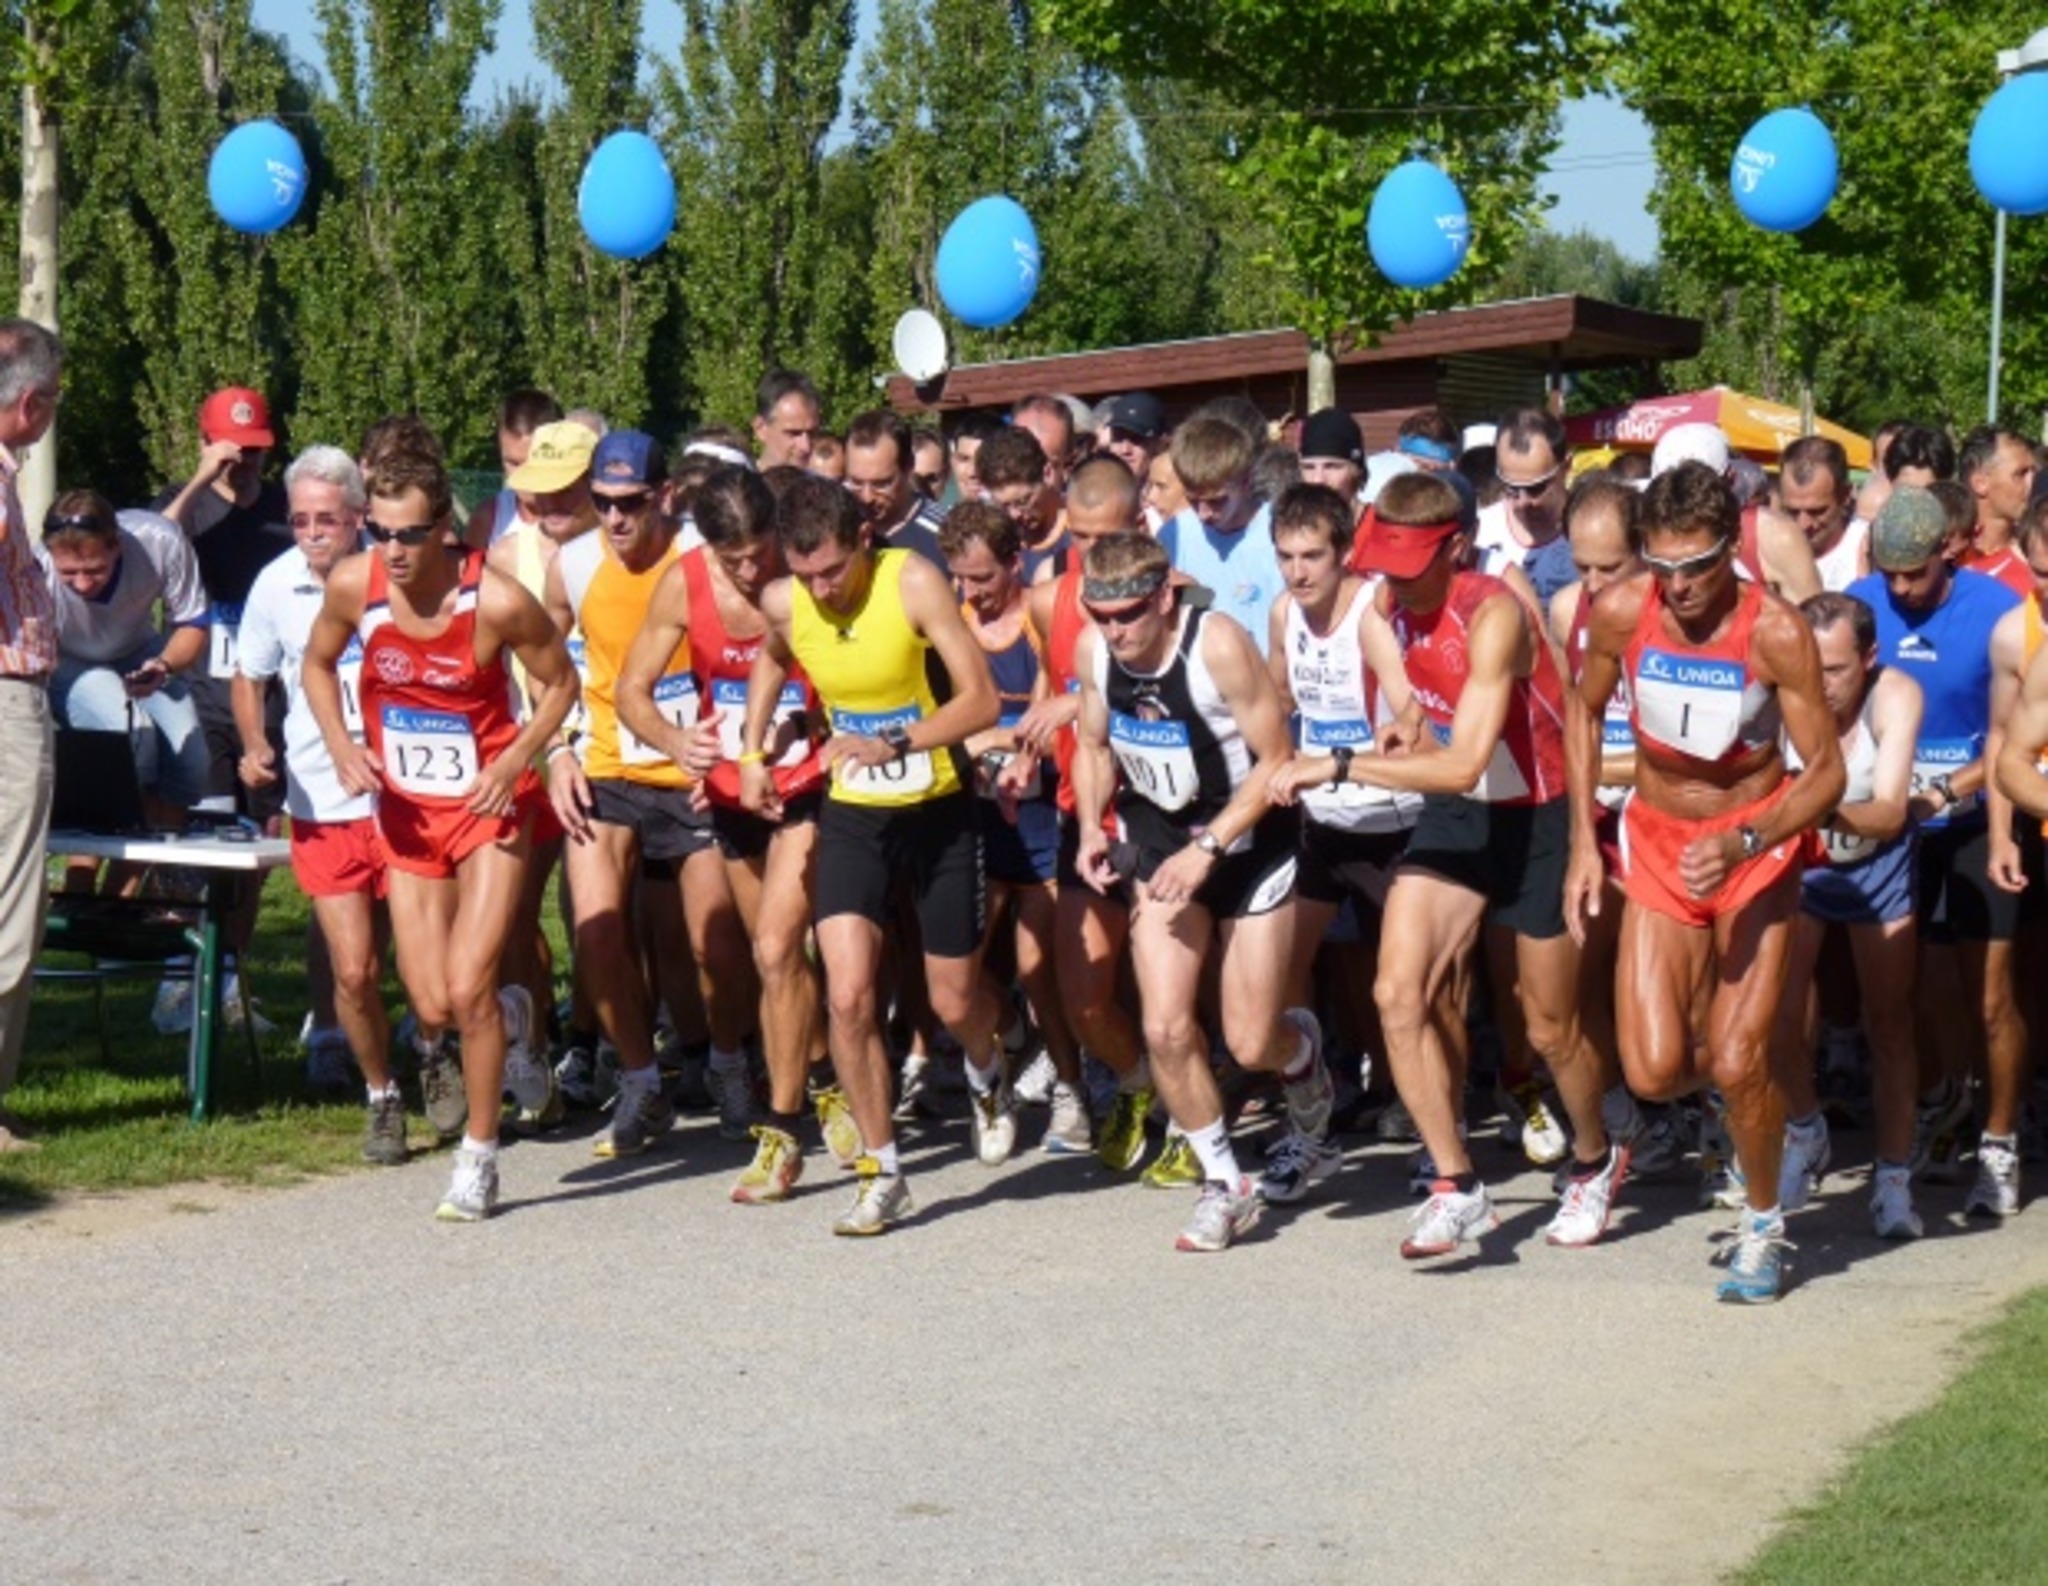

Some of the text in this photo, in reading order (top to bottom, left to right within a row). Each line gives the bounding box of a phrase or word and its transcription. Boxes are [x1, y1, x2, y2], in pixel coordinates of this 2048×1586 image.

[1677, 666, 1736, 687] UNIQA
[1680, 702, 1690, 737] 1
[395, 744, 465, 781] 123
